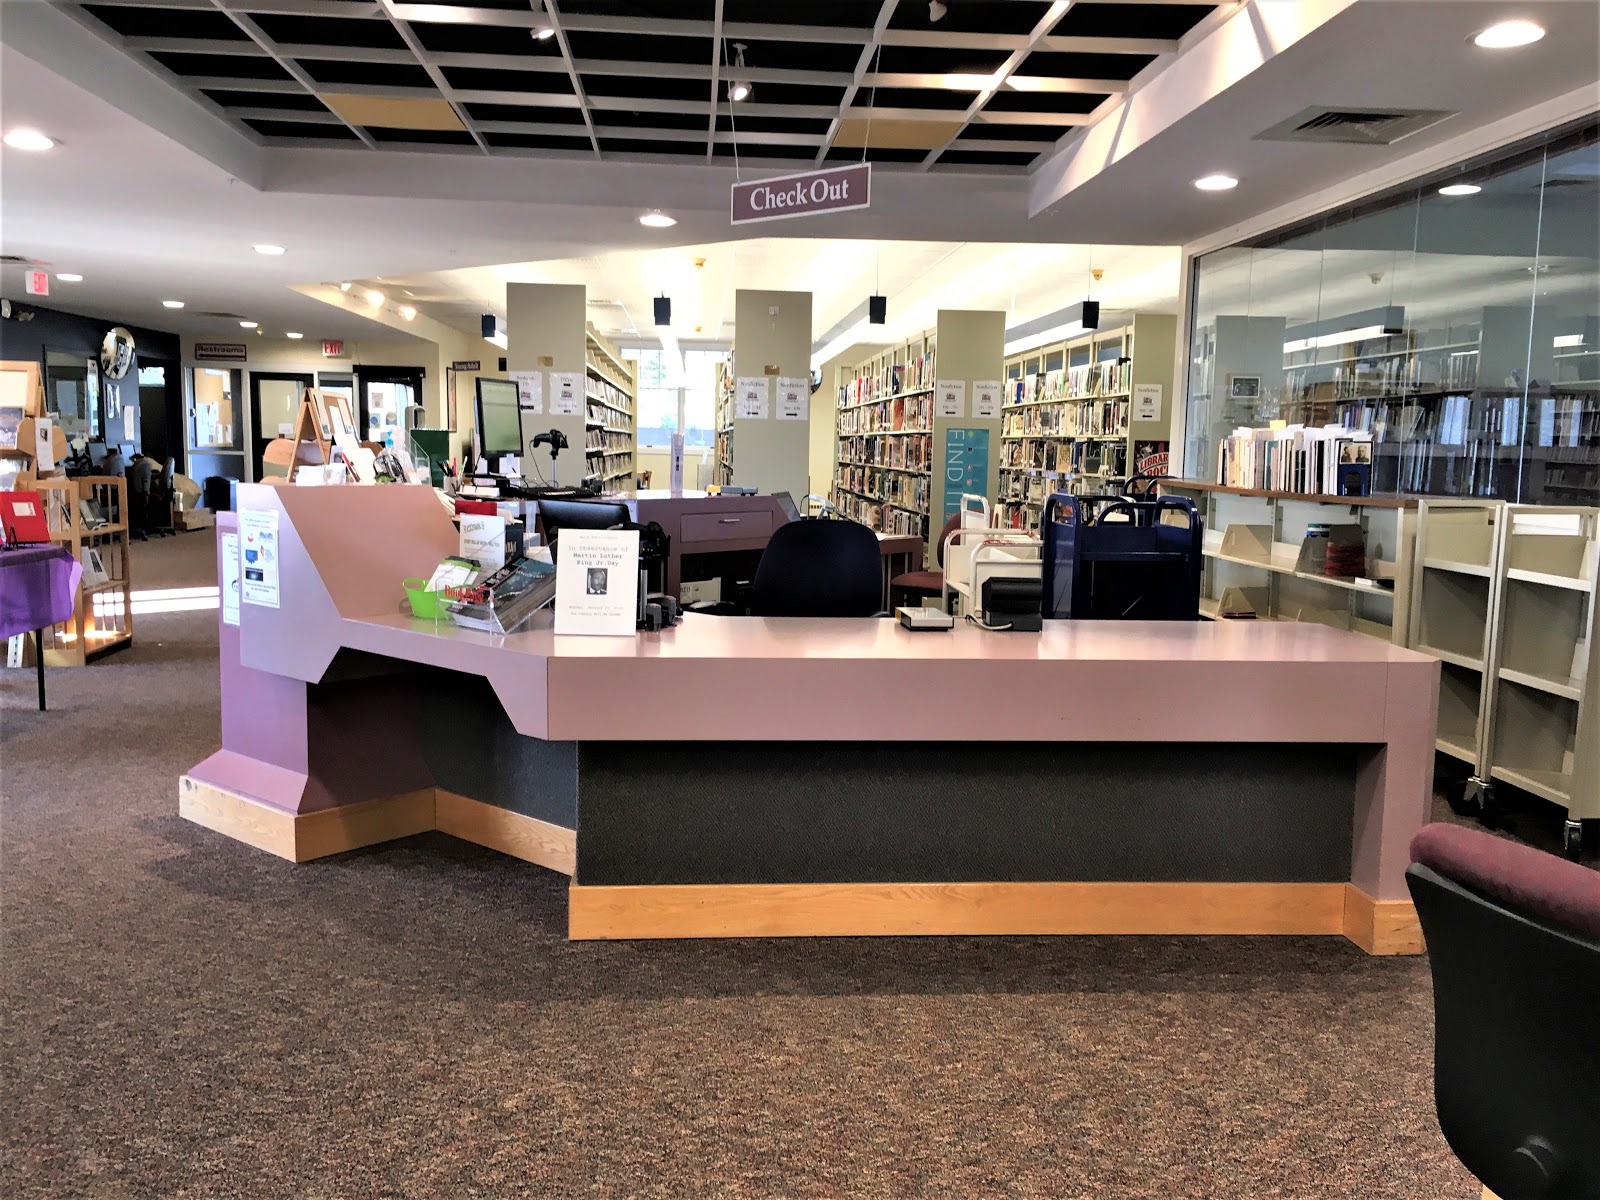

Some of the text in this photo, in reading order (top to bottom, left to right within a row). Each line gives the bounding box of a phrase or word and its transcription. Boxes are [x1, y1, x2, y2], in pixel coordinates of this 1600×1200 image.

[750, 178, 849, 211] Check Out
[197, 345, 244, 353] Restrooms
[324, 341, 341, 354] EXIT
[946, 430, 965, 482] FIND
[1140, 453, 1169, 471] LIBRAR
